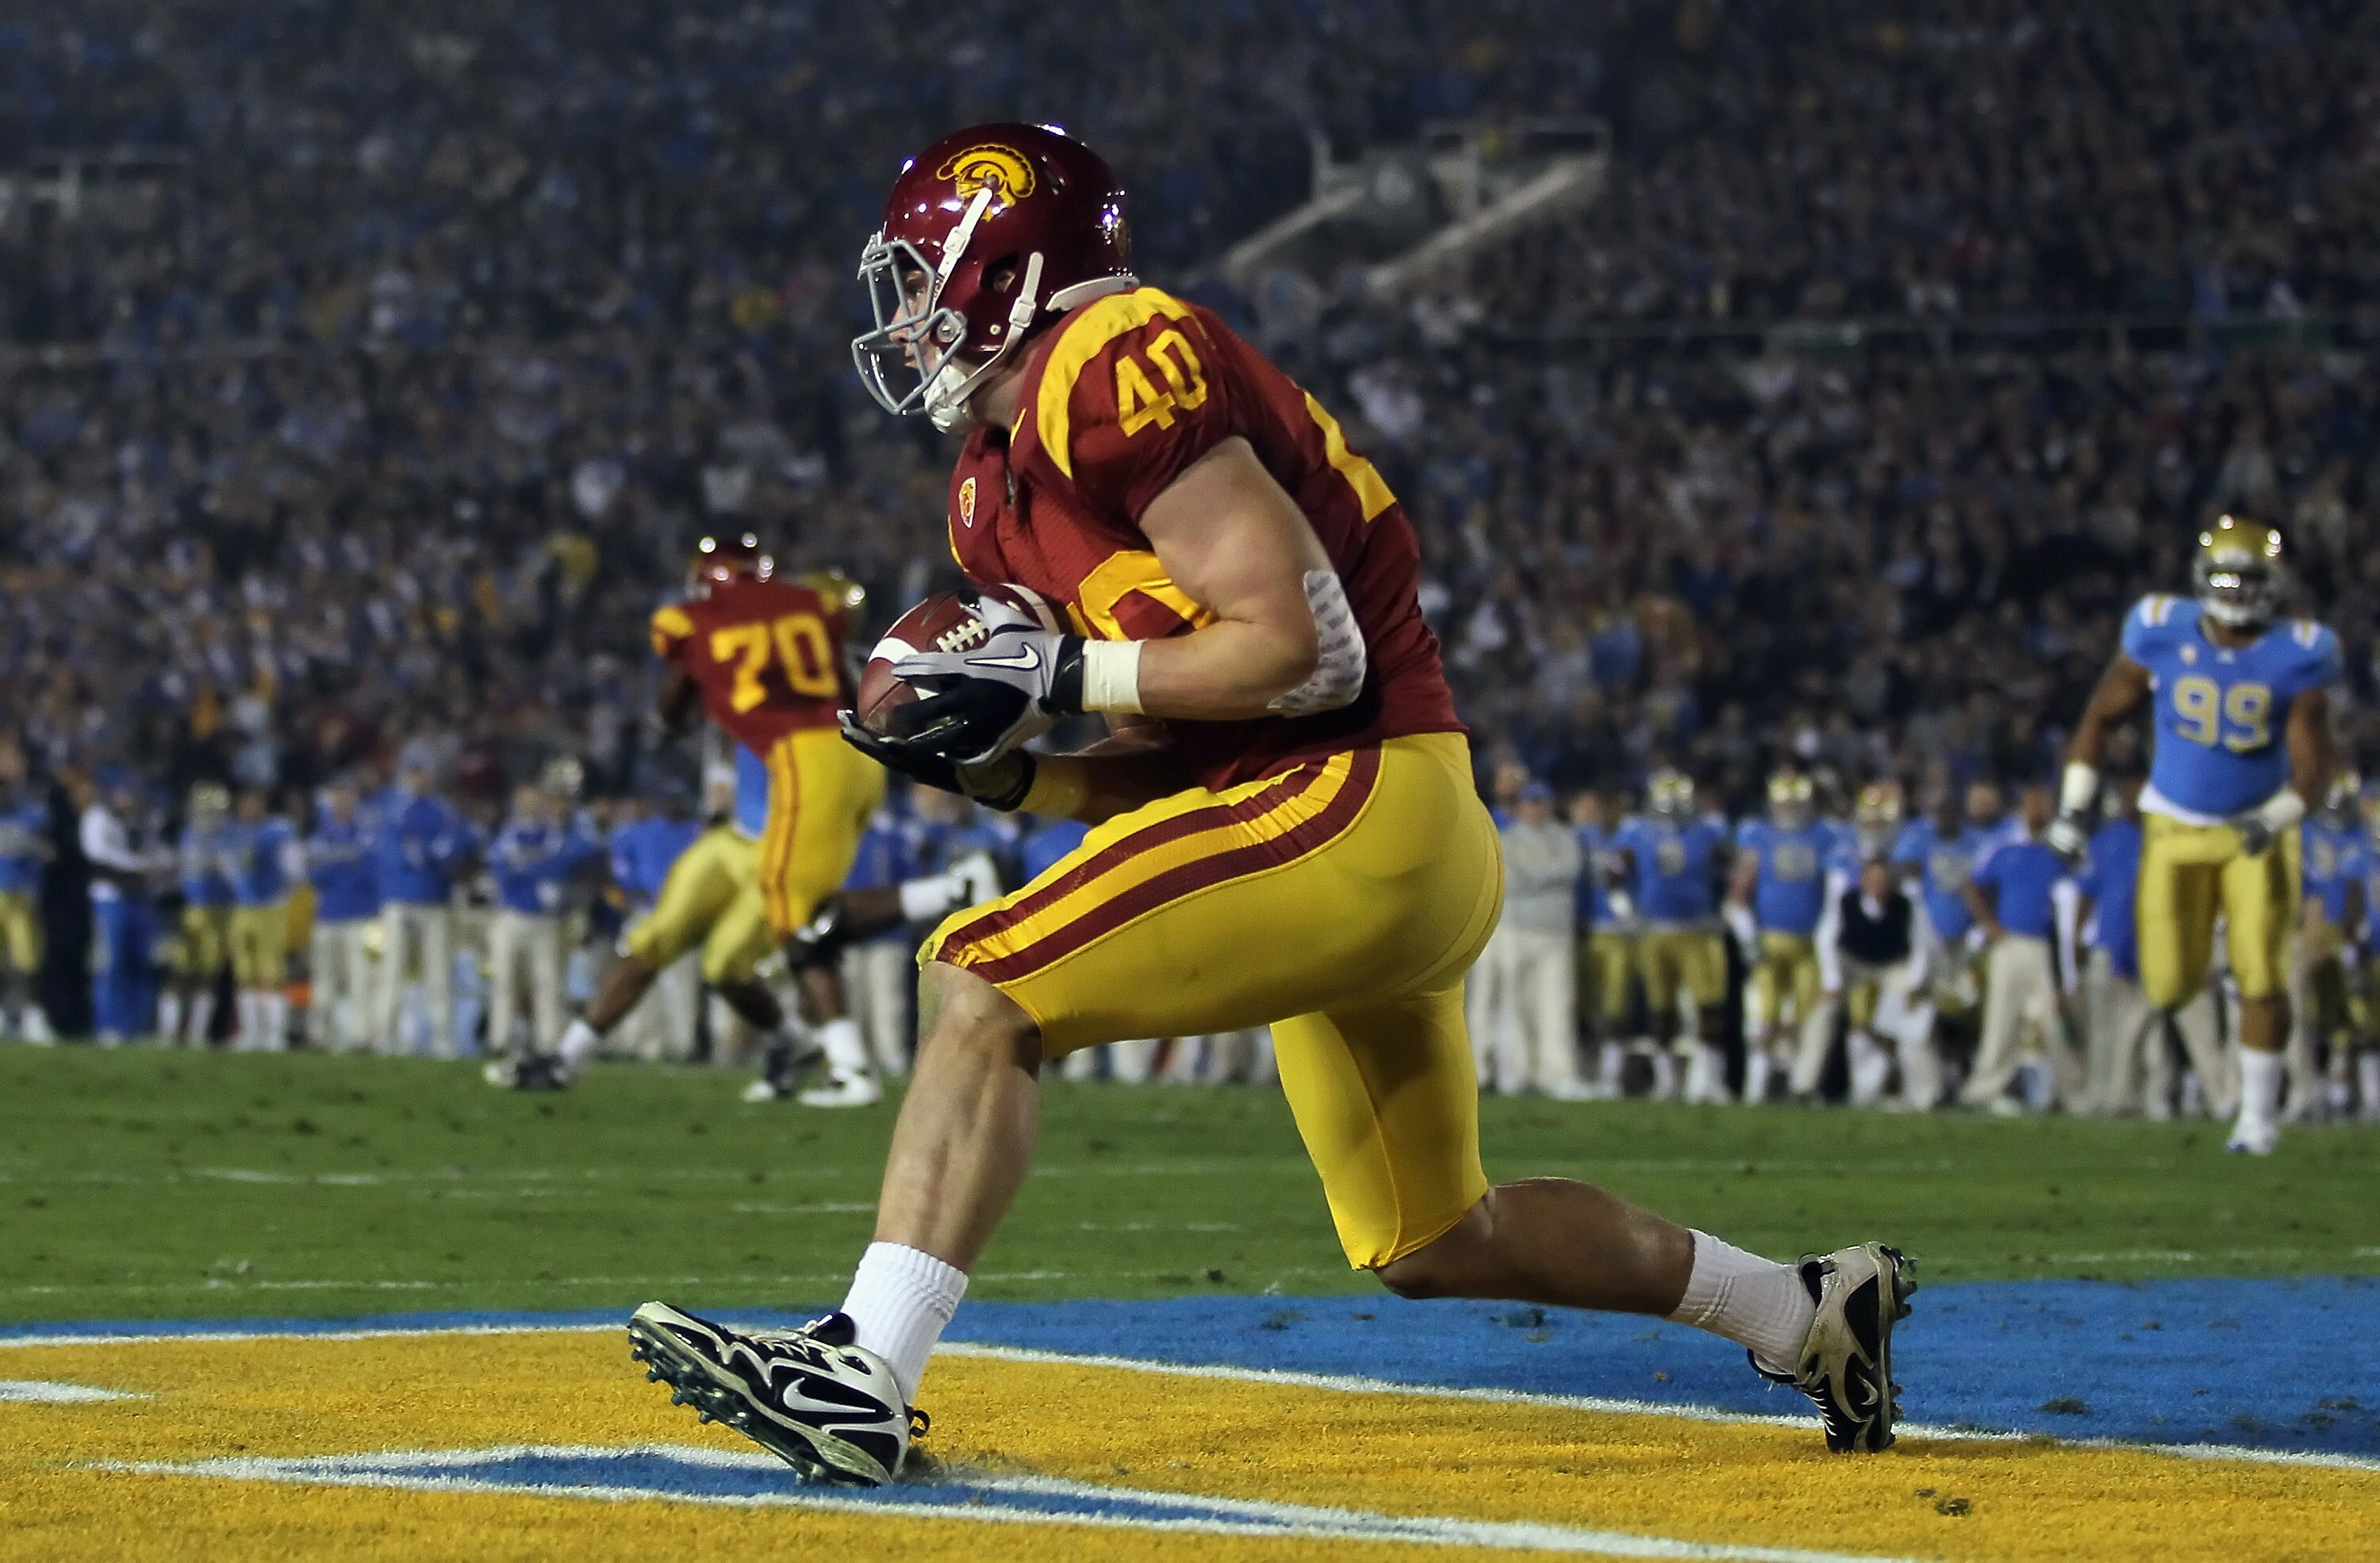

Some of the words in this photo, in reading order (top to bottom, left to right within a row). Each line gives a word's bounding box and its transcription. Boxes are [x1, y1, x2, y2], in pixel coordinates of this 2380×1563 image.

[1115, 329, 1207, 437] 40
[709, 611, 841, 713] 70
[2173, 674, 2271, 753] 99
